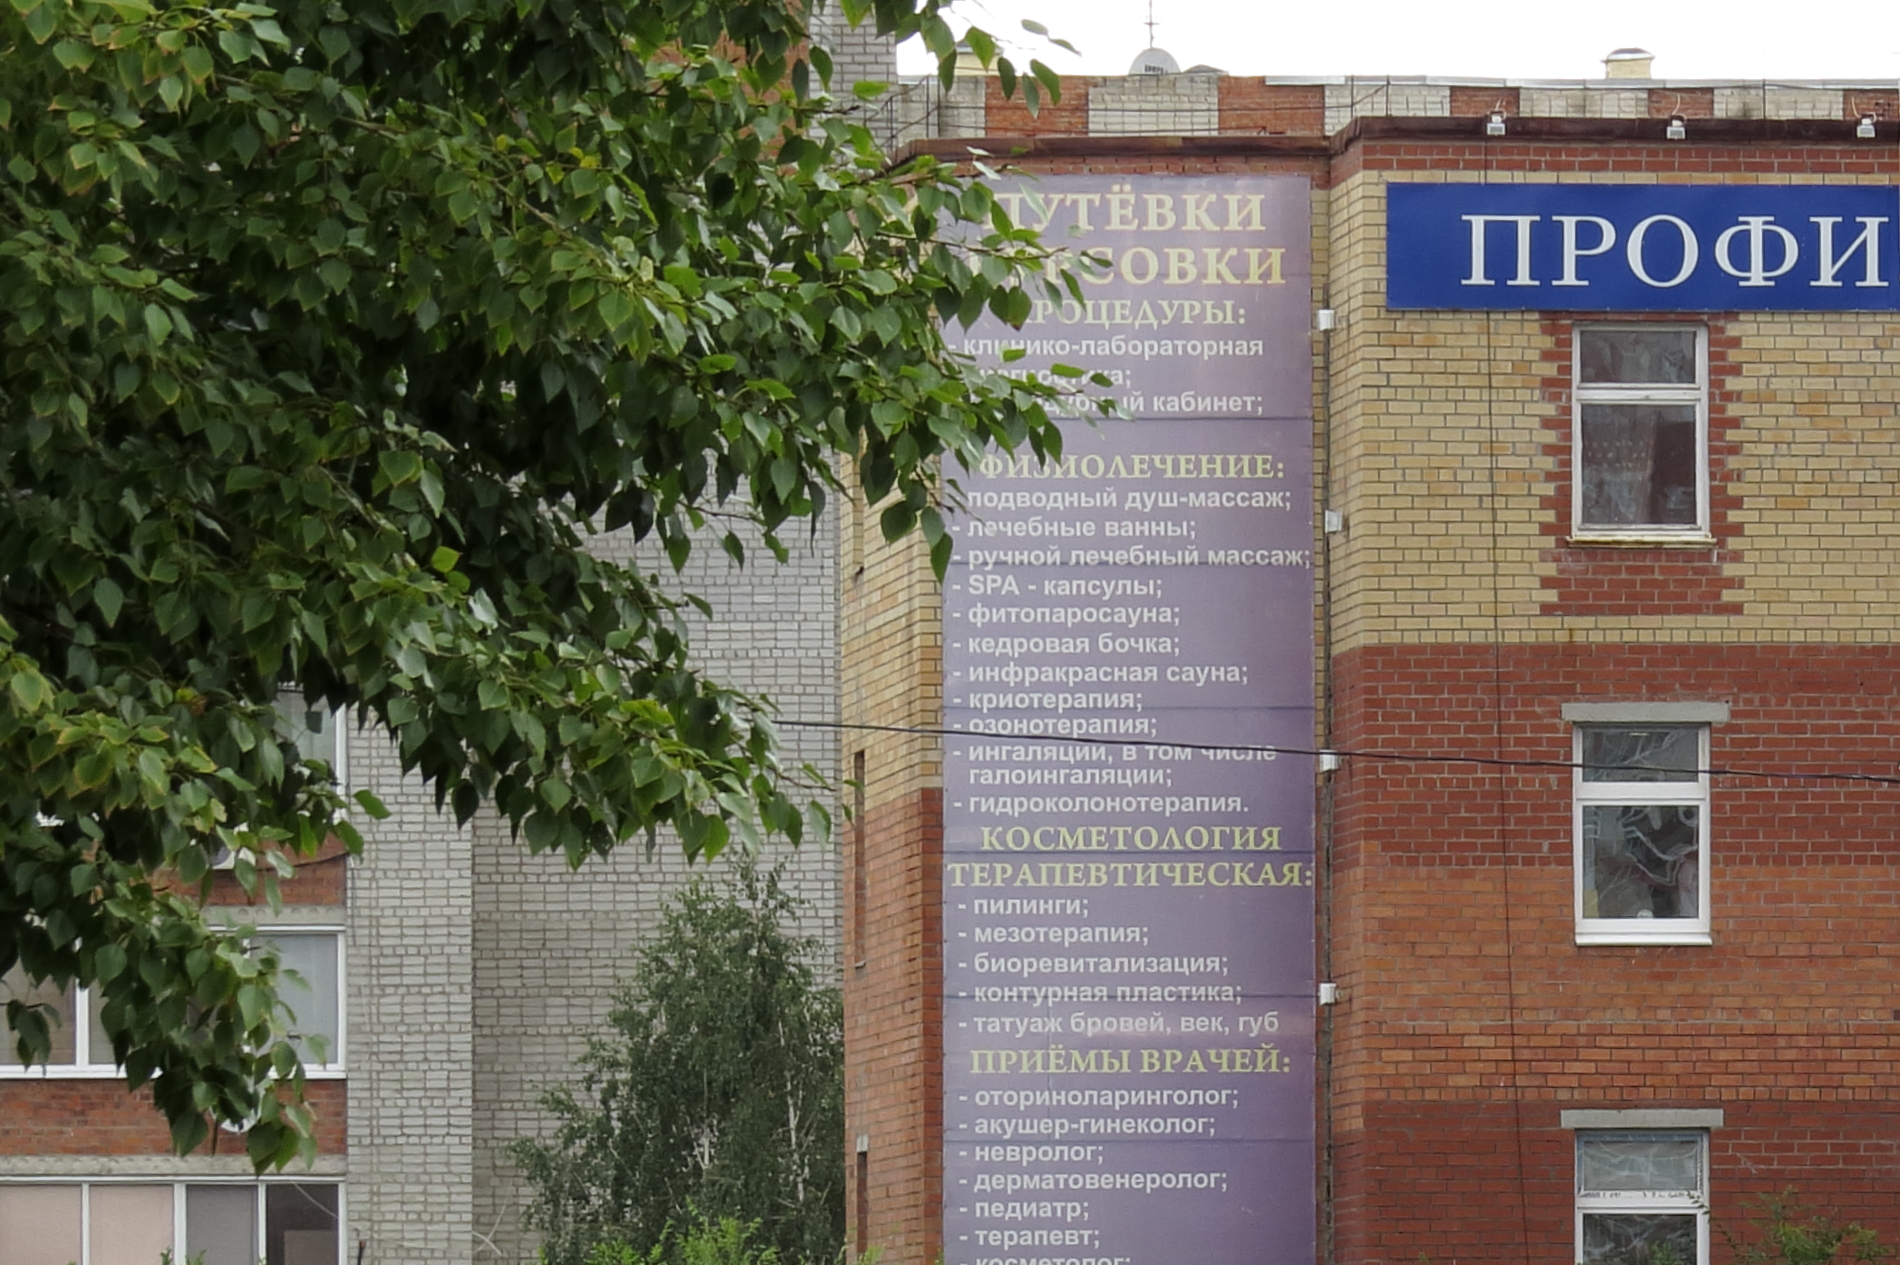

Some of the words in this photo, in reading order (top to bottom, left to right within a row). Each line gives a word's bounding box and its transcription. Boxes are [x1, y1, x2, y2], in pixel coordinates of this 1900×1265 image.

[984, 184, 1266, 231] ПУТЁВКИ
[969, 247, 1286, 285] РСОВКИ
[1022, 300, 1246, 329] РОЦЕДУРЫ:
[1153, 390, 1263, 416] кабинет;
[979, 453, 1284, 479] ФИЗИОЛЕЧЕНИЕ:
[967, 486, 1117, 511] подводный
[1124, 491, 1291, 513] душ-массаж;
[968, 518, 1097, 538] лечебные
[1105, 520, 1196, 540] ванны;
[968, 545, 1061, 571] ручной
[1069, 544, 1199, 566] лечебный
[1207, 549, 1310, 570] массаж;
[968, 574, 1020, 596] SPA
[1044, 579, 1162, 601] капсулы;
[968, 602, 1180, 629] фитопаросауна;
[968, 637, 1090, 659] кедровая
[1098, 632, 1180, 657] бочка;
[969, 661, 1158, 687] инфракрасная
[1166, 666, 1248, 687] сауна;
[969, 692, 1142, 714] криотерапия;
[968, 717, 1157, 739] озонотерапия;
[969, 743, 1114, 764] ингаляции,
[1121, 746, 1138, 761] в
[1146, 746, 1193, 761] том
[1201, 747, 1277, 761] числе
[969, 768, 1172, 788] галоингаляции;
[969, 796, 1249, 818] гидроколонотерапия.
[980, 825, 1282, 851] КОСМЕТОЛОГИЯ
[947, 862, 1313, 888] ТЕРАПЕВТИЧЕСКАЯ:
[973, 898, 1089, 918] пилинги;
[974, 926, 1148, 948] мезотерапия;
[974, 951, 1228, 978] биоревитализация;
[974, 986, 1108, 1007] контурная
[1117, 983, 1242, 1005] пластика;
[973, 1017, 1063, 1037] татуаж
[1070, 1011, 1172, 1037] бровей,
[1180, 1016, 1230, 1036] век,
[1238, 1010, 1279, 1037] губ
[970, 1044, 1132, 1074] ПРИЁМЫ
[1139, 1042, 1290, 1073] ВРАЧЕЙ:
[975, 1089, 1239, 1111] оториноларинголог;
[974, 1117, 1215, 1140] акушер-гинеколог;
[975, 1145, 1103, 1167] невролог;
[973, 1172, 1227, 1195] дерматовенеролог;
[975, 1201, 1089, 1223] педиатр;
[974, 1229, 1100, 1251] терапевт;
